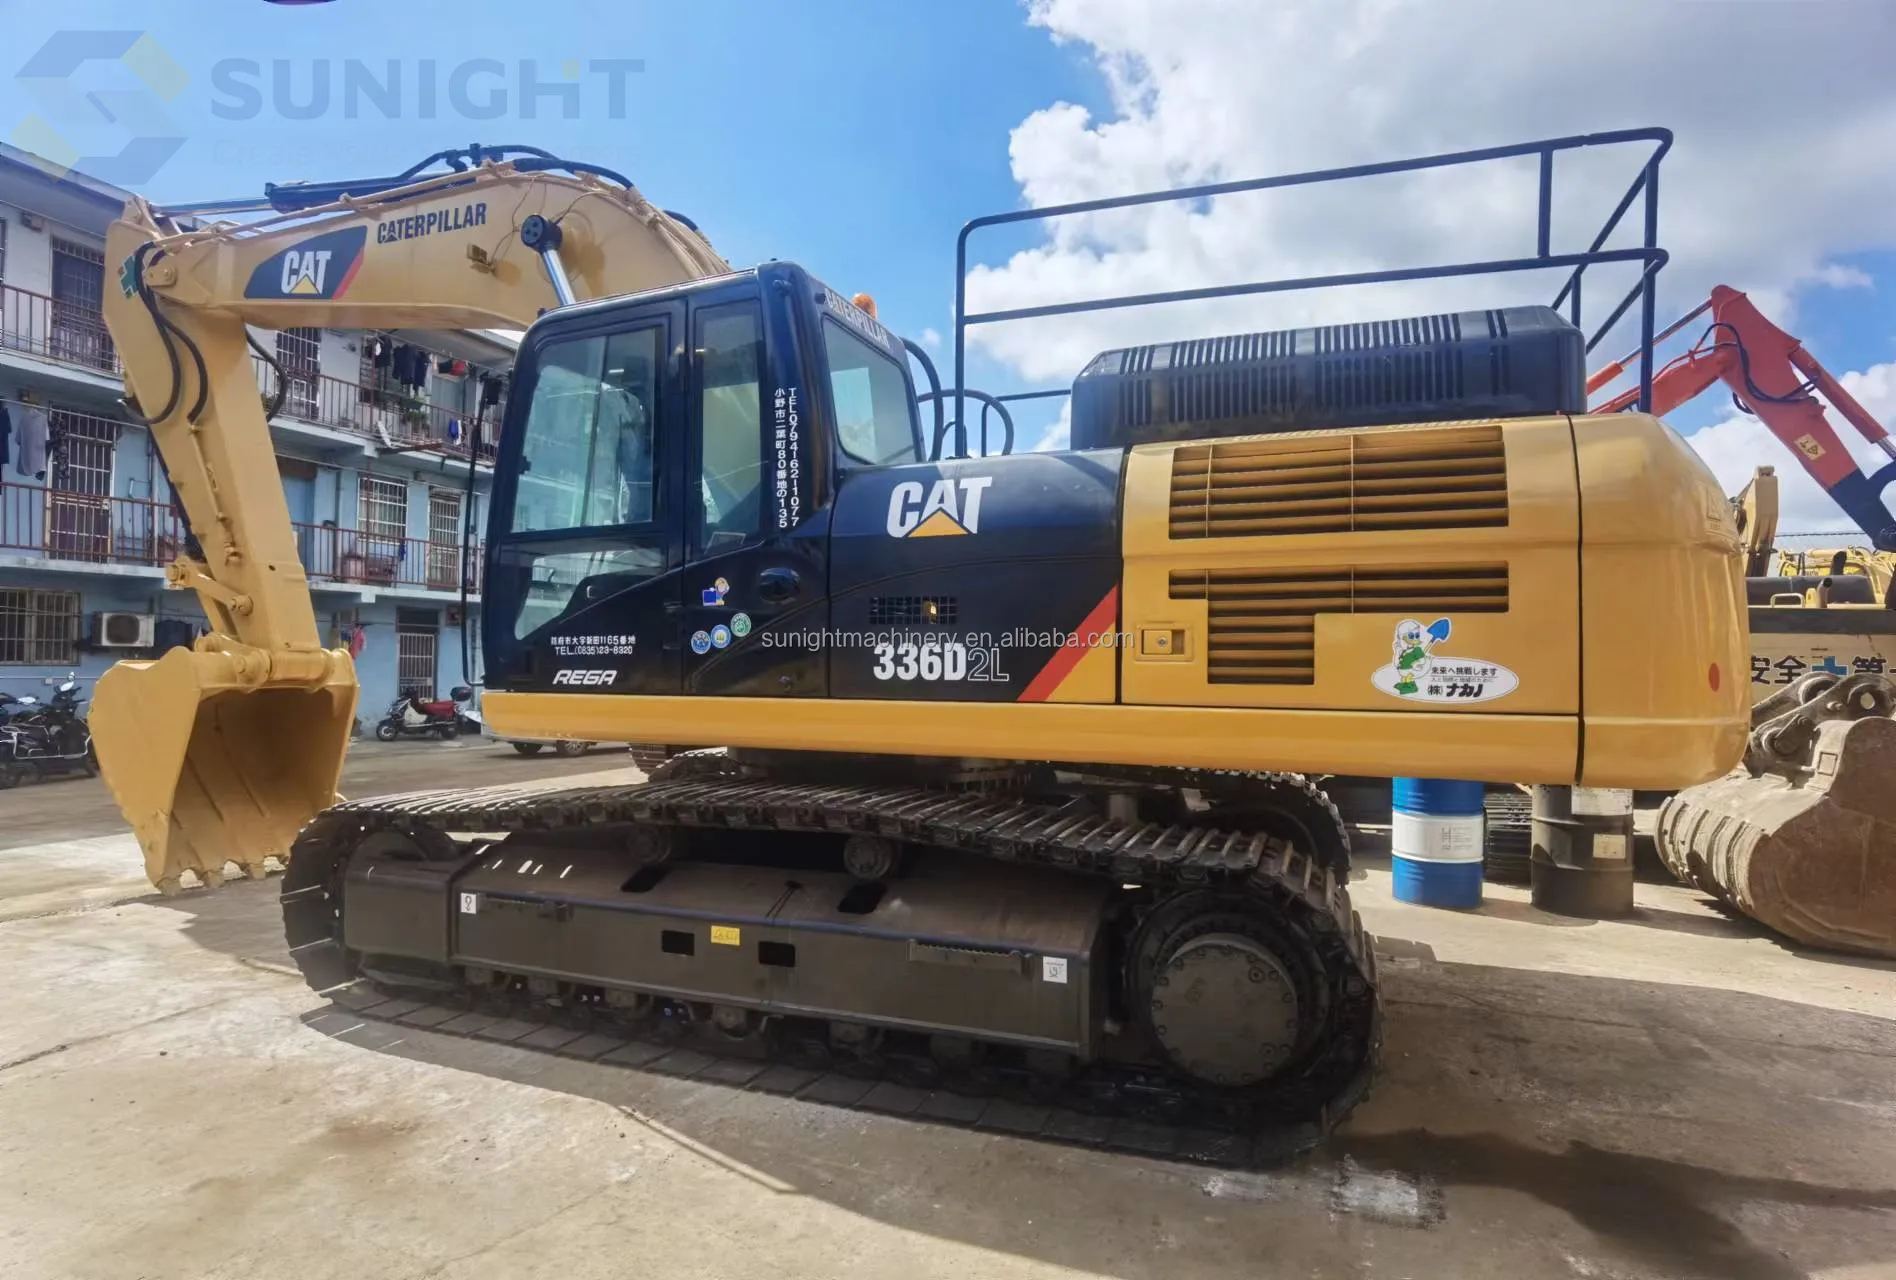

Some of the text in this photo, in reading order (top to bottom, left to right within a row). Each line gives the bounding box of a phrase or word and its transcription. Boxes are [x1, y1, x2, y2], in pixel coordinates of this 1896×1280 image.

[377, 202, 487, 244] CATERPILLAR
[281, 251, 332, 294] CAT
[886, 476, 993, 538] CAT
[552, 669, 618, 686] REGA
